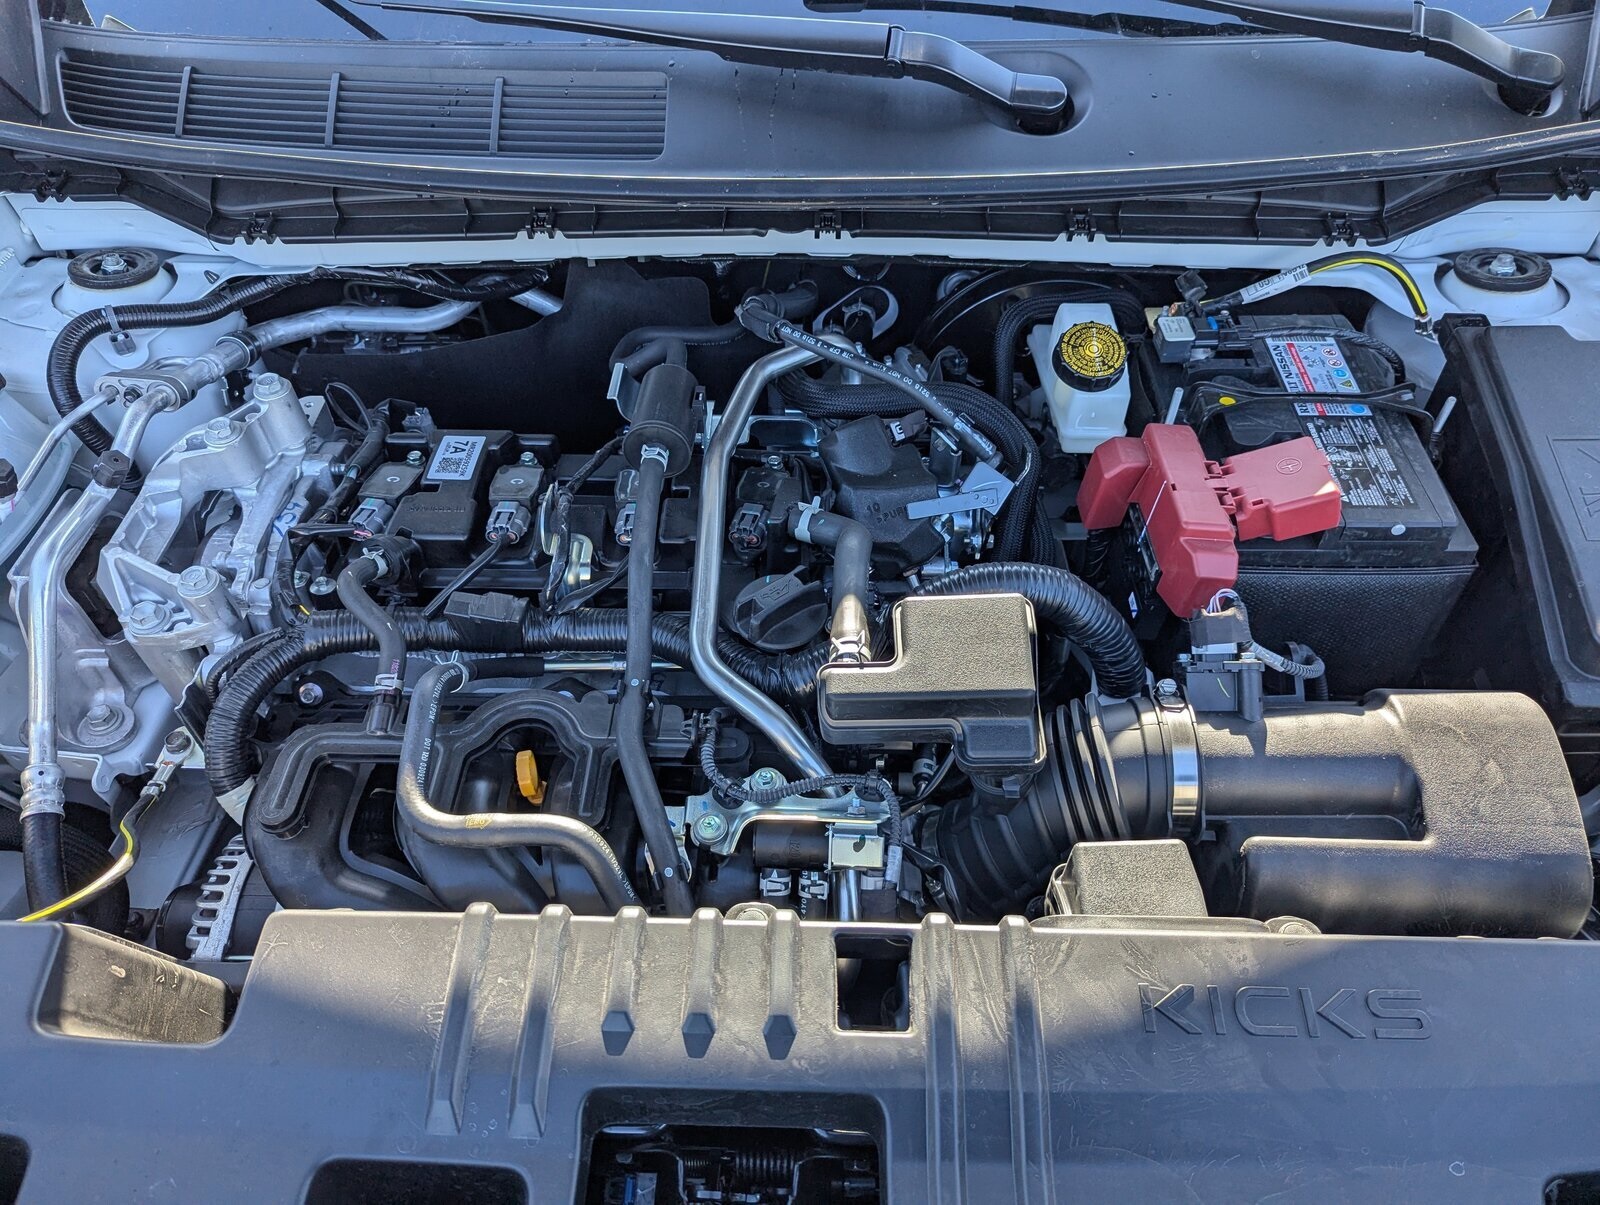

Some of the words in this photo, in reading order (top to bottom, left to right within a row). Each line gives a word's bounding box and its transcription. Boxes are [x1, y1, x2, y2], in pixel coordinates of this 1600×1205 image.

[1272, 344, 1295, 379] NISSAN
[449, 440, 470, 455] 7A
[1137, 982, 1432, 1040] KICKS
